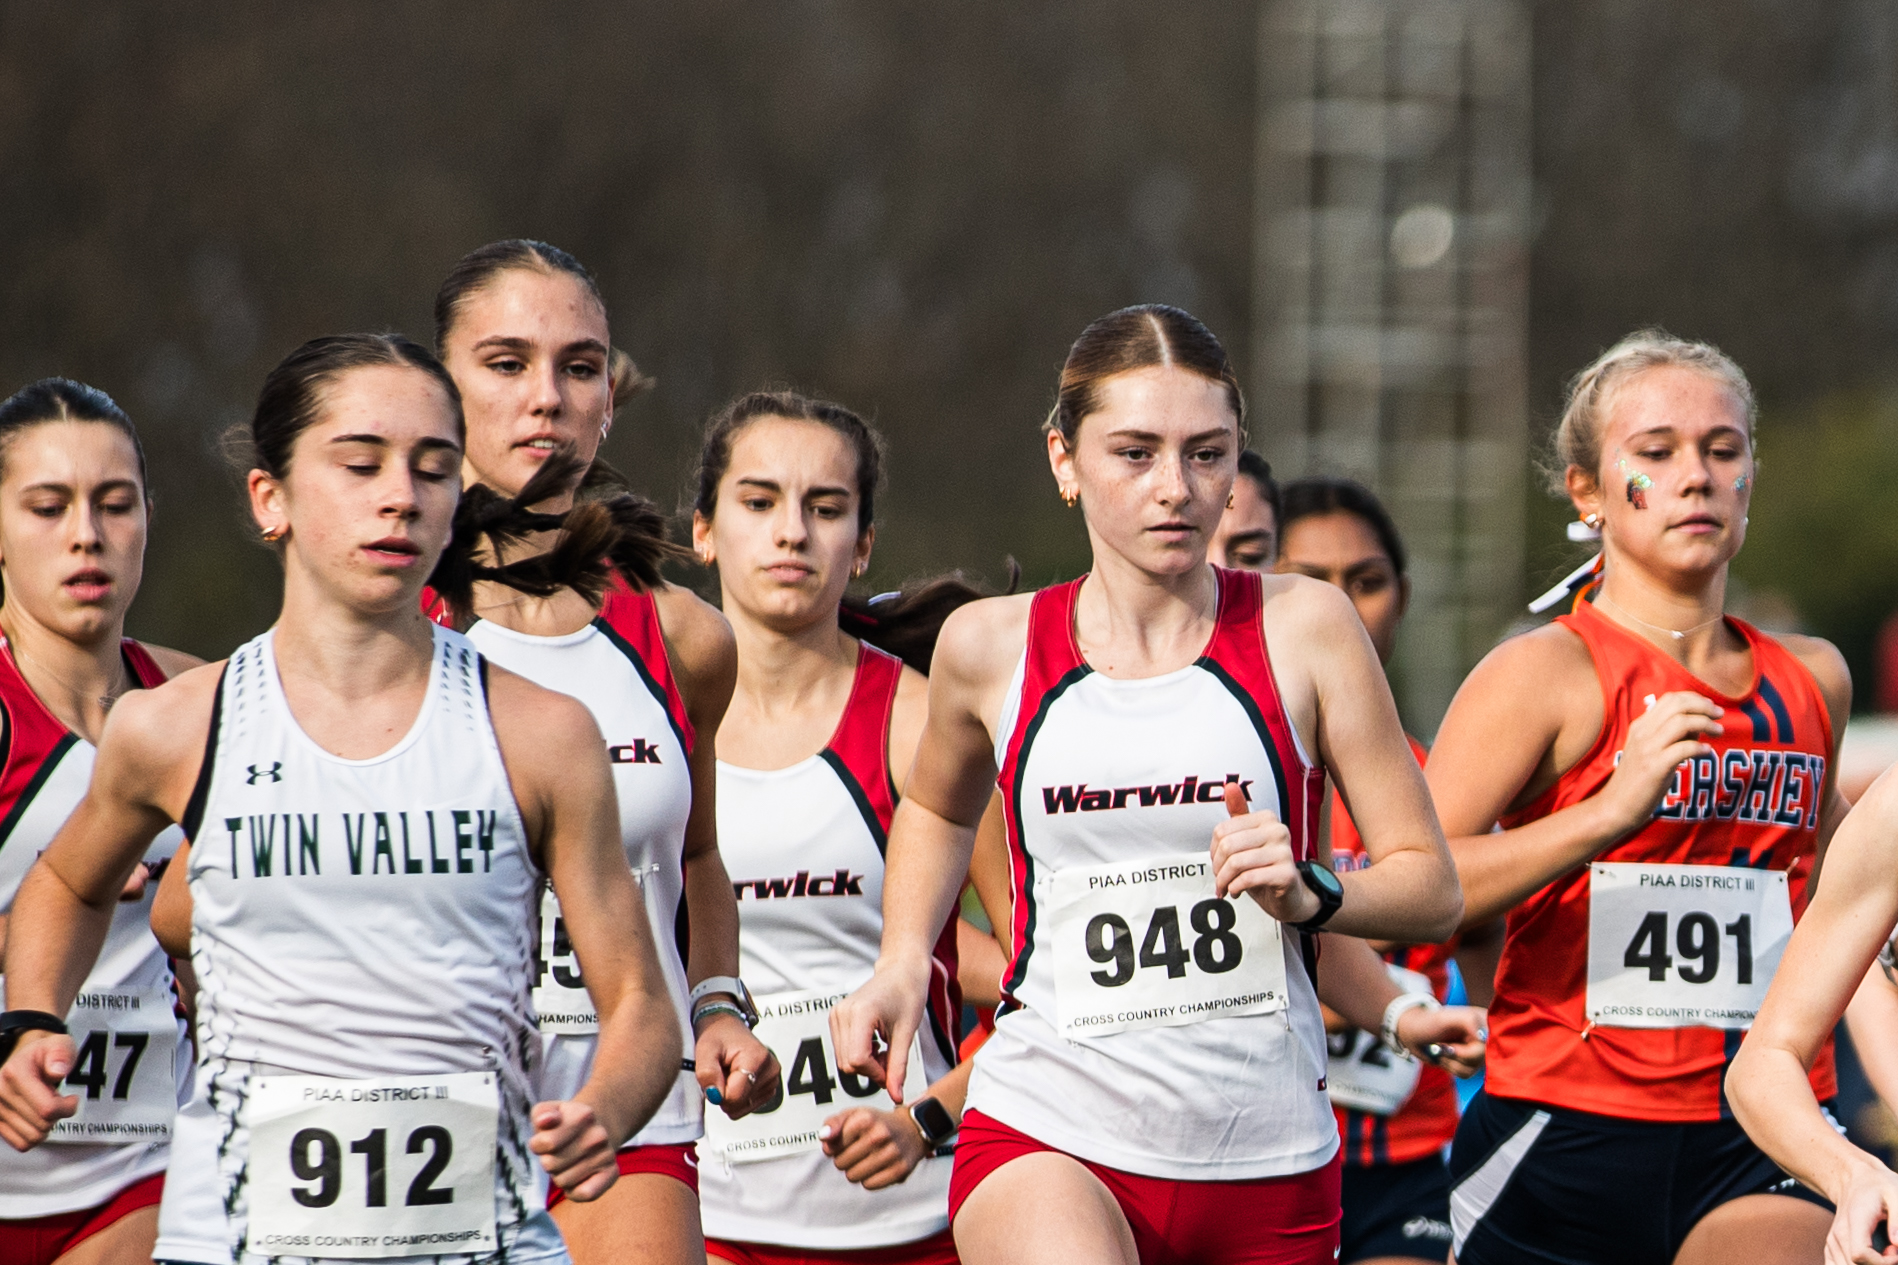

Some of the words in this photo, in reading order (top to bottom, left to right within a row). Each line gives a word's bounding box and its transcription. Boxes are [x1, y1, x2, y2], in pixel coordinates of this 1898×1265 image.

[1041, 773, 1254, 815] Warwick
[1613, 748, 1825, 830] ERSHEY
[225, 813, 320, 879] TWIN
[343, 810, 496, 875] VALLEY
[1089, 875, 1127, 889] PIAA
[1132, 863, 1207, 884] DISTRICT
[1640, 873, 1676, 887] PIAA
[1680, 874, 1742, 890] DISTRICT
[1745, 878, 1756, 891] III
[1085, 898, 1243, 988] 948
[1624, 910, 1753, 984] 491
[76, 993, 128, 1011] DISTRICT
[1074, 1012, 1114, 1027] CROSS
[1118, 1006, 1175, 1022] COUNTRY
[1180, 991, 1274, 1014] CHAMPIONSHIPS
[1603, 1005, 1643, 1017] CROSS
[1647, 1006, 1702, 1018] COUNTRY
[303, 1088, 344, 1101] PIAA
[351, 1086, 430, 1102] DISTRICT
[435, 1086, 448, 1099] III
[727, 1139, 766, 1152] CROSS
[290, 1125, 454, 1208] 912
[265, 1234, 310, 1246] CROSS
[315, 1235, 378, 1247] COUNTRY
[382, 1230, 481, 1247] CHAMPIONSHIPS
